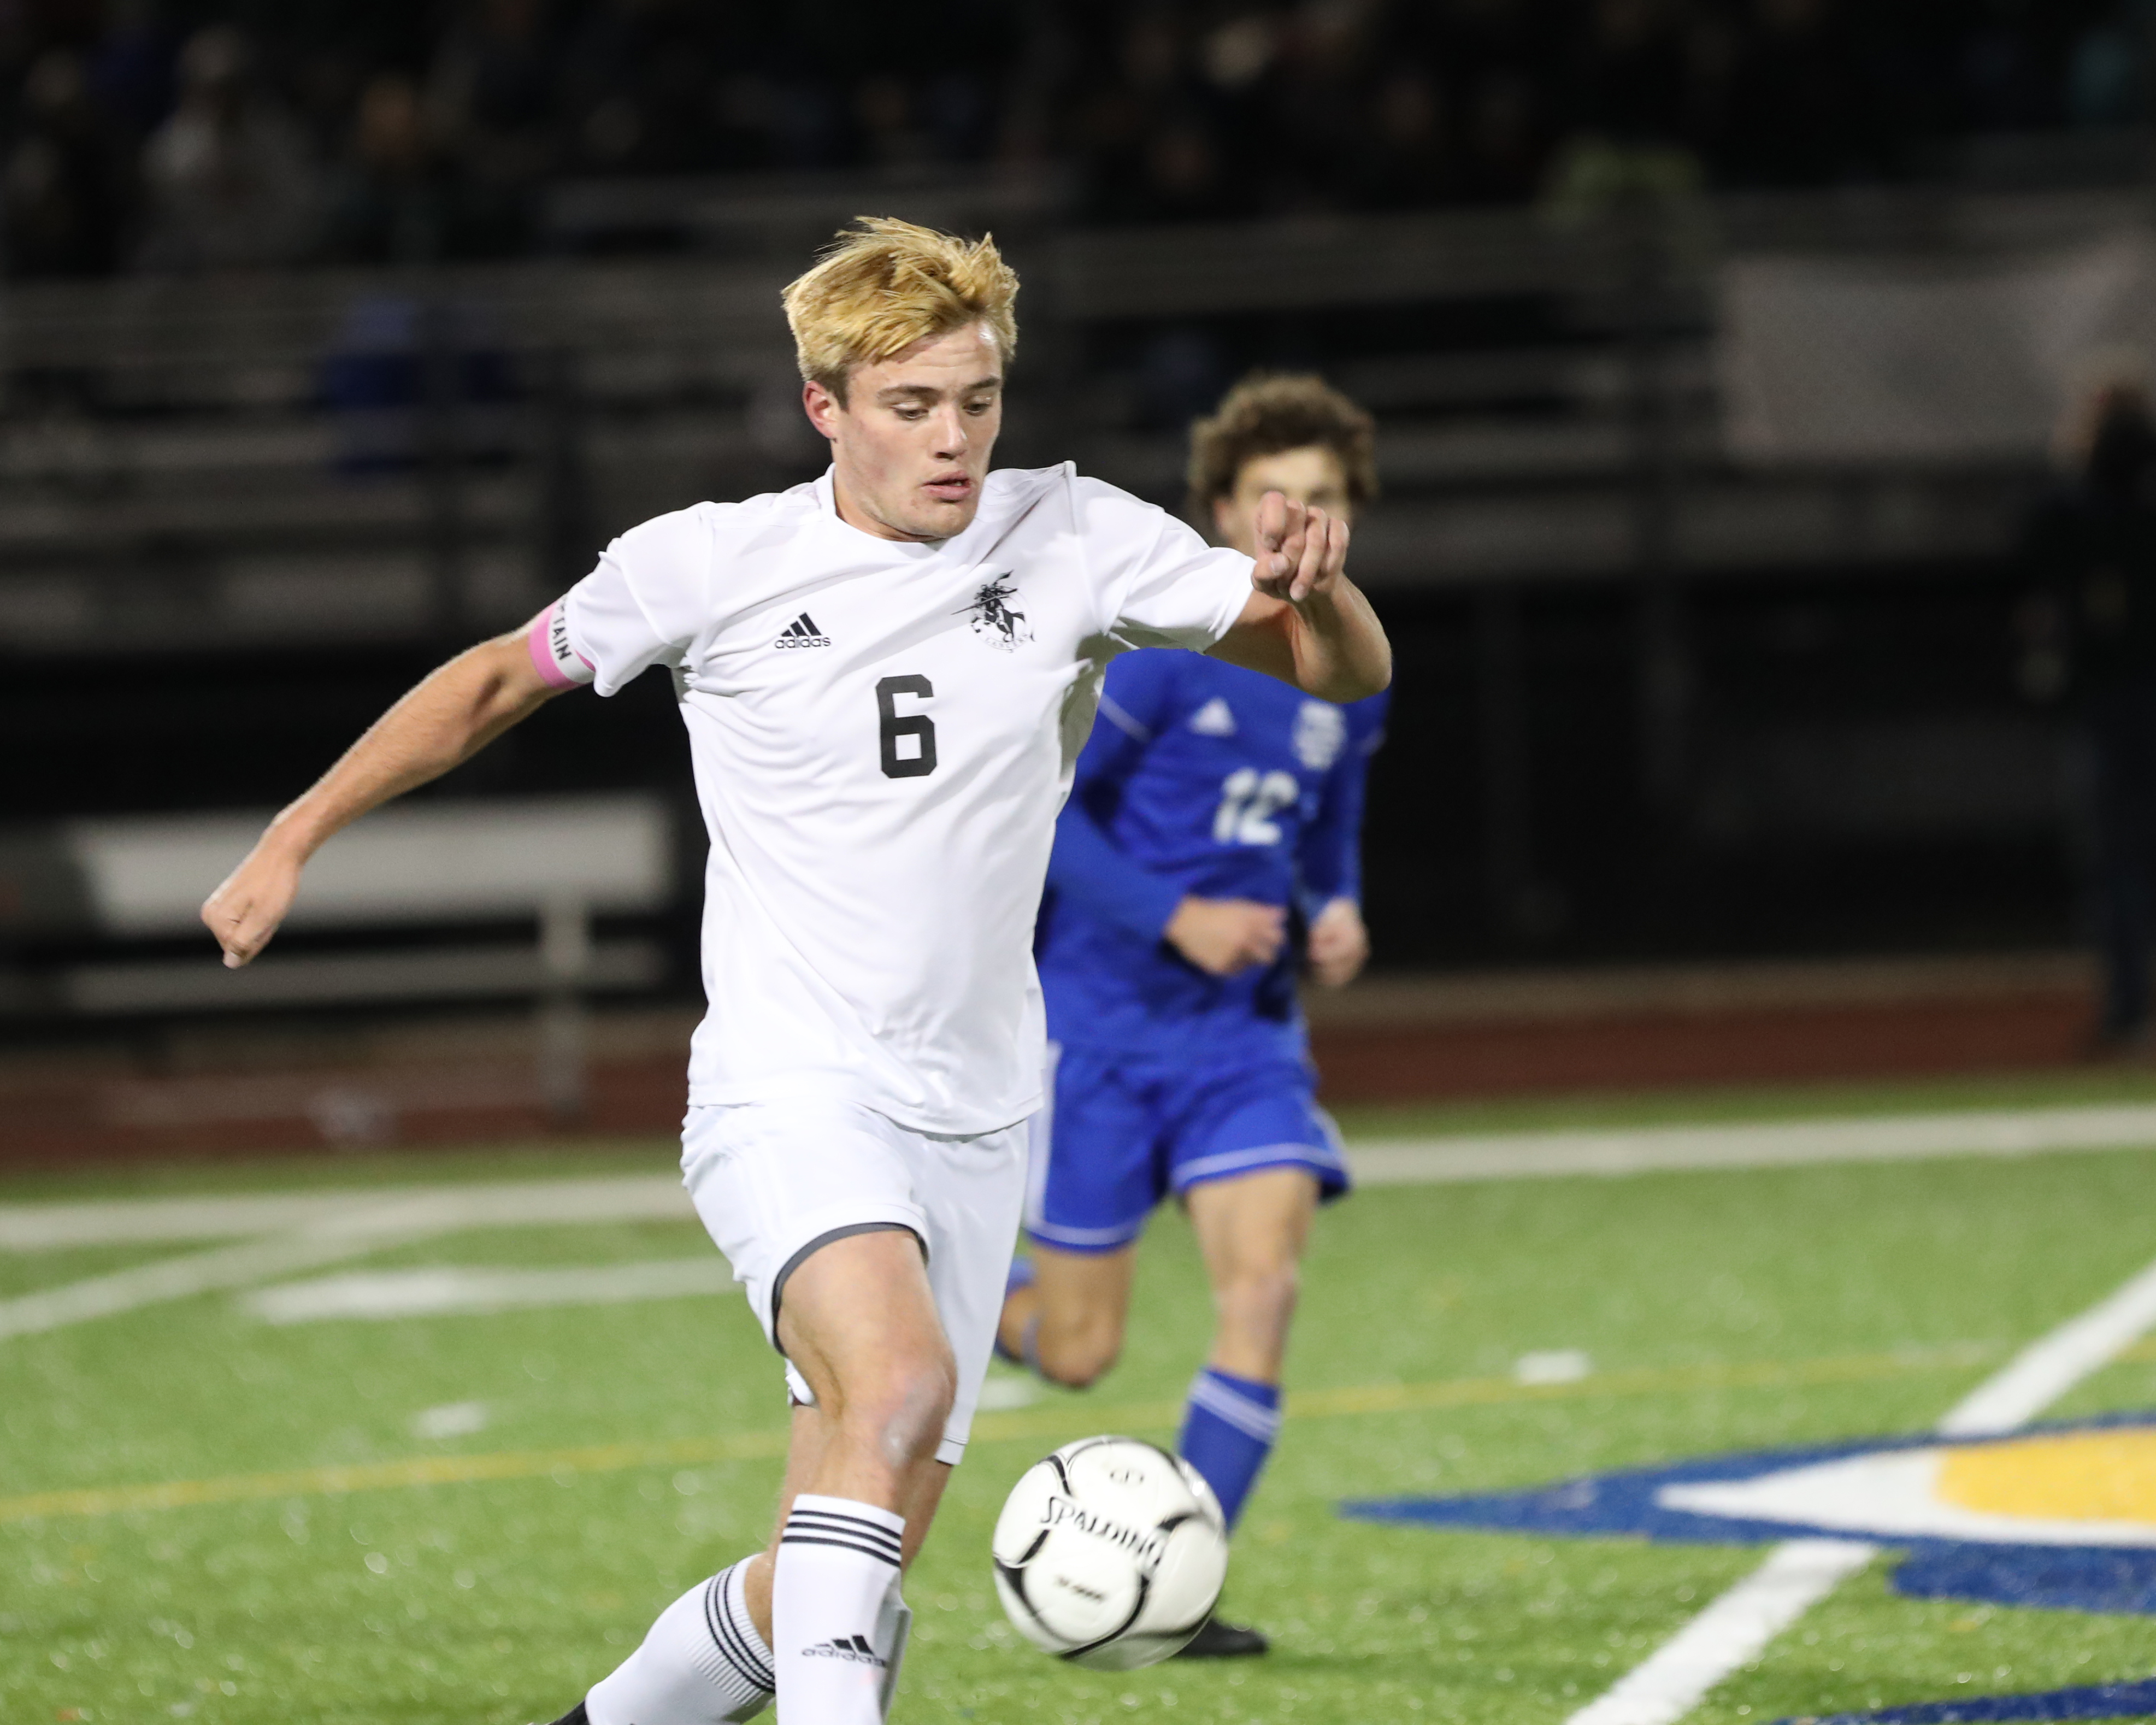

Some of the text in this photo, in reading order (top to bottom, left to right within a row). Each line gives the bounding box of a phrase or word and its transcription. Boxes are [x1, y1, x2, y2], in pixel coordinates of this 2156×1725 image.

[775, 635, 831, 649] adidas
[875, 674, 938, 779] 6
[1212, 767, 1300, 845] 12
[1040, 1496, 1163, 1567] SPALDING
